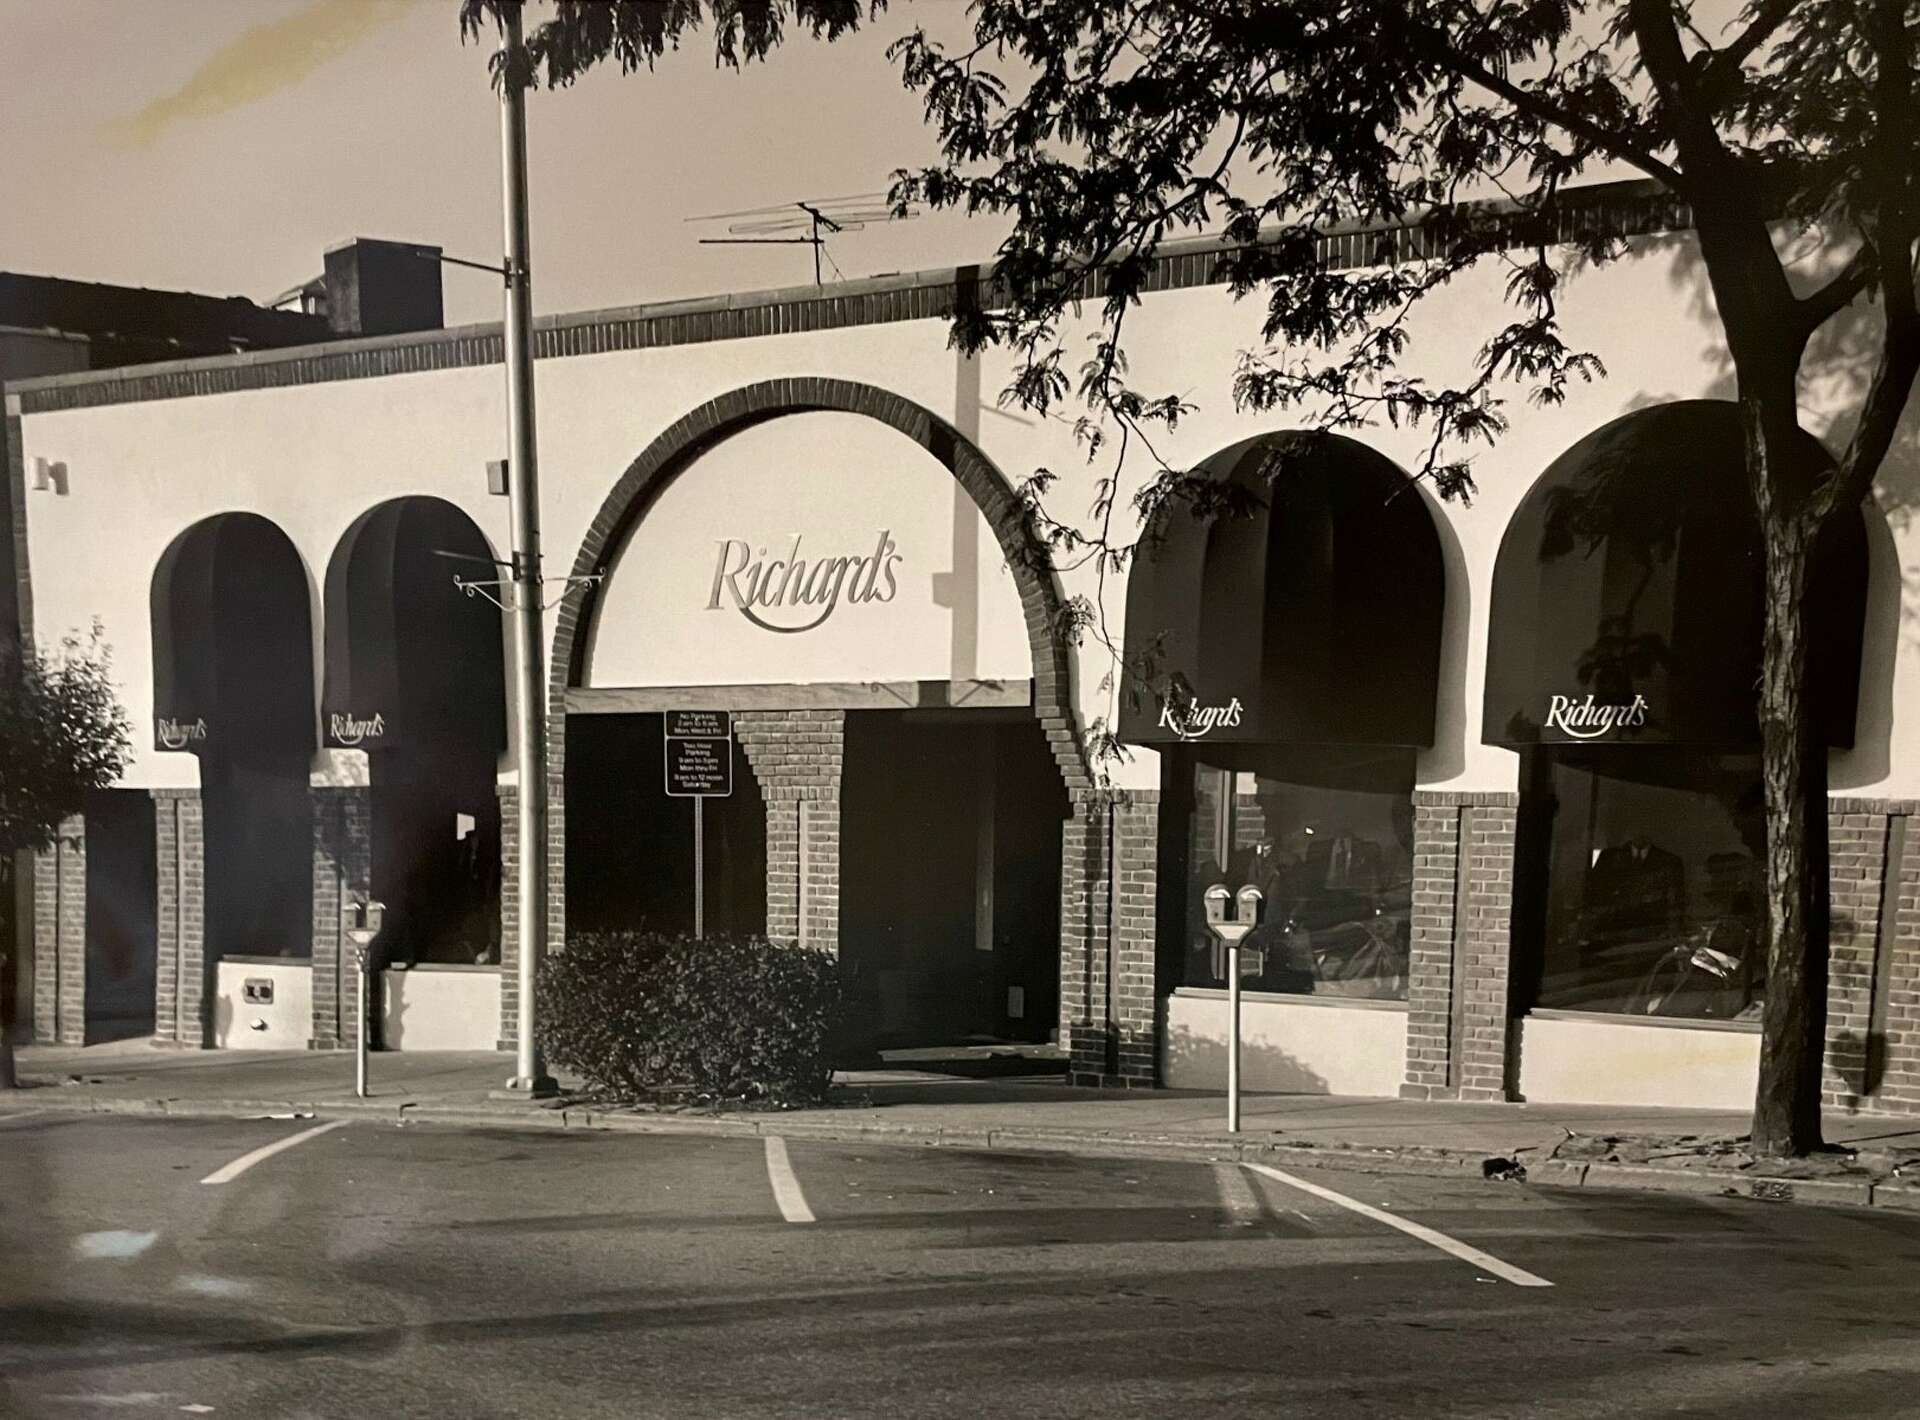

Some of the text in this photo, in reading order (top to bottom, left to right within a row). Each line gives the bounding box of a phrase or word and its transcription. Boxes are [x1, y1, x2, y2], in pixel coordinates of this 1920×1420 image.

[704, 529, 903, 633] Richard's
[331, 713, 385, 745] Richard's
[1544, 694, 1648, 738] Richard's
[158, 718, 207, 749] Richard's
[685, 749, 711, 757] Parking
